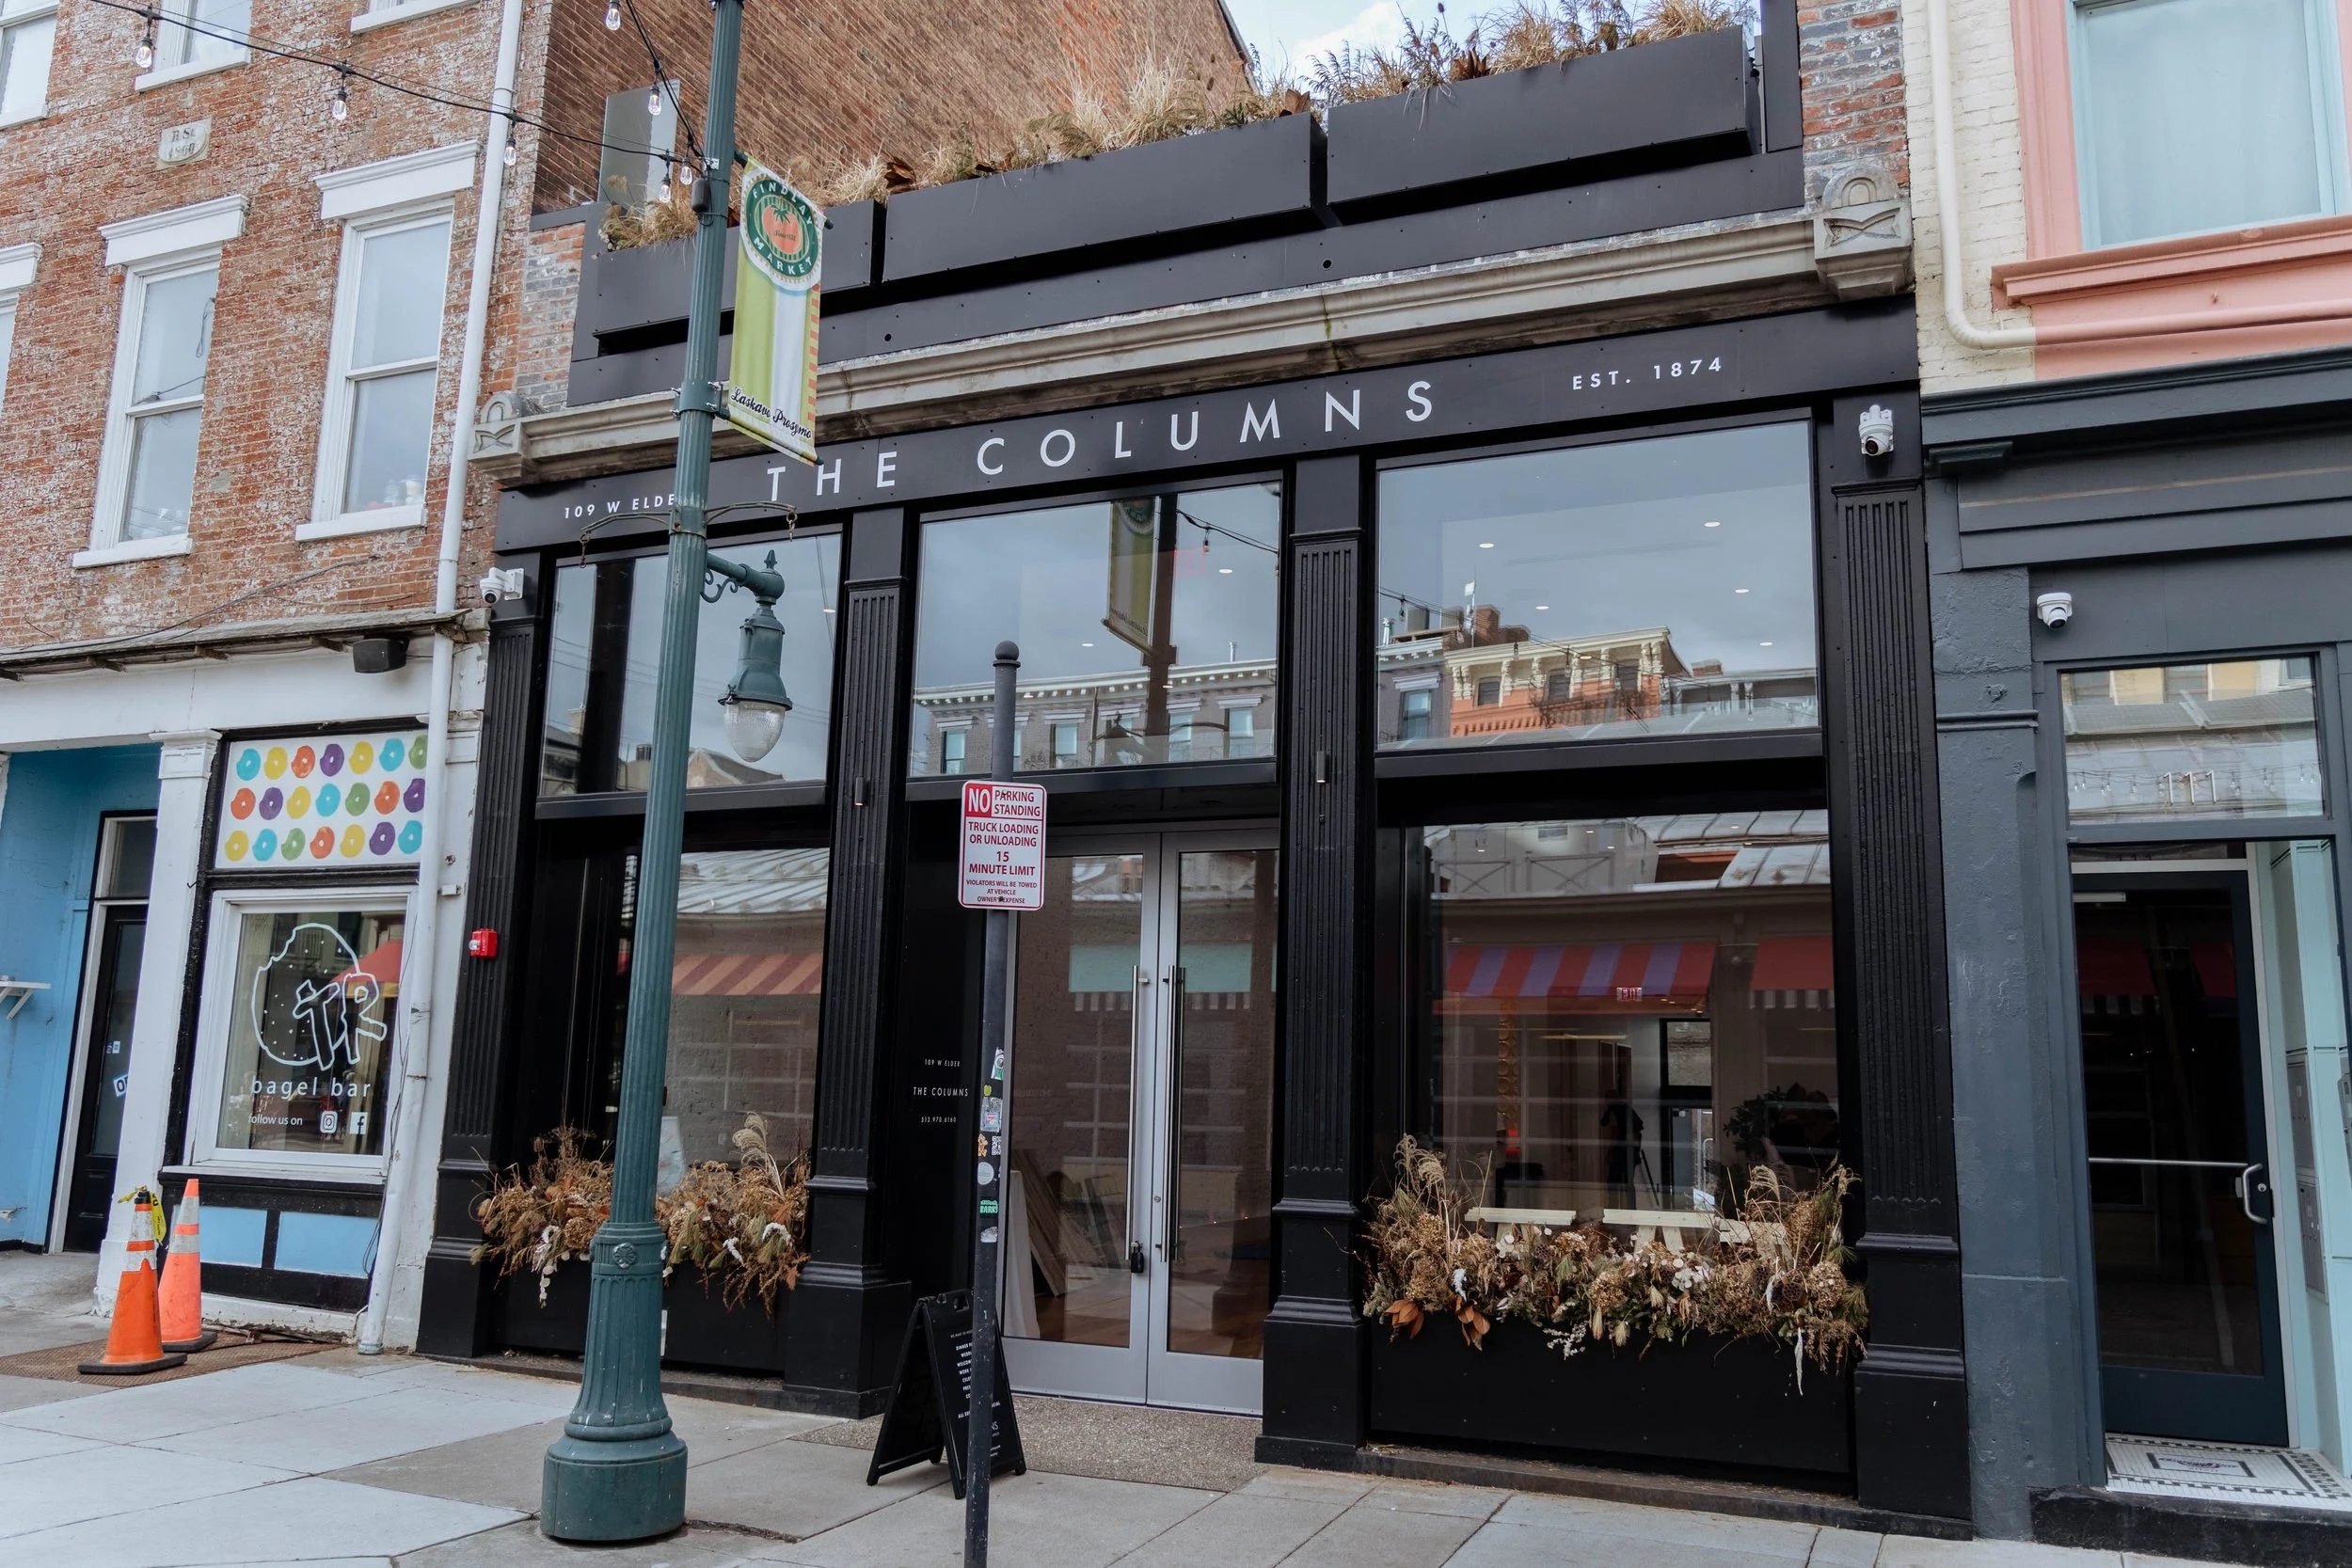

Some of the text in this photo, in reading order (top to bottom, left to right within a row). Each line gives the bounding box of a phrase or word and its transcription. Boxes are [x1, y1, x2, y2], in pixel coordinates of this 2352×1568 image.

[753, 182, 813, 225] FINDLAY
[754, 237, 812, 275] MARKET
[1572, 357, 1722, 390] EST. 1874
[731, 387, 812, 438] Laskavo Prosymo
[767, 380, 1434, 502] THE COLUMNS
[564, 494, 675, 518] 109 W ELDE
[2163, 770, 2217, 805] 111
[968, 787, 991, 814] NO
[994, 790, 1035, 802] PARKING
[994, 803, 1041, 817] STANDING
[968, 821, 1039, 834] TRUCK LOADING
[969, 833, 1037, 847] OR UNLOADING
[996, 851, 1009, 863] 15
[969, 863, 1036, 876] MINUTE LIMIT
[1621, 988, 1639, 1001] EXIT
[944, 1059, 961, 1068] ELDER
[250, 1076, 372, 1101] bagel bar
[913, 1086, 969, 1097] THE COLUMNS
[248, 1113, 303, 1126] follow us on
